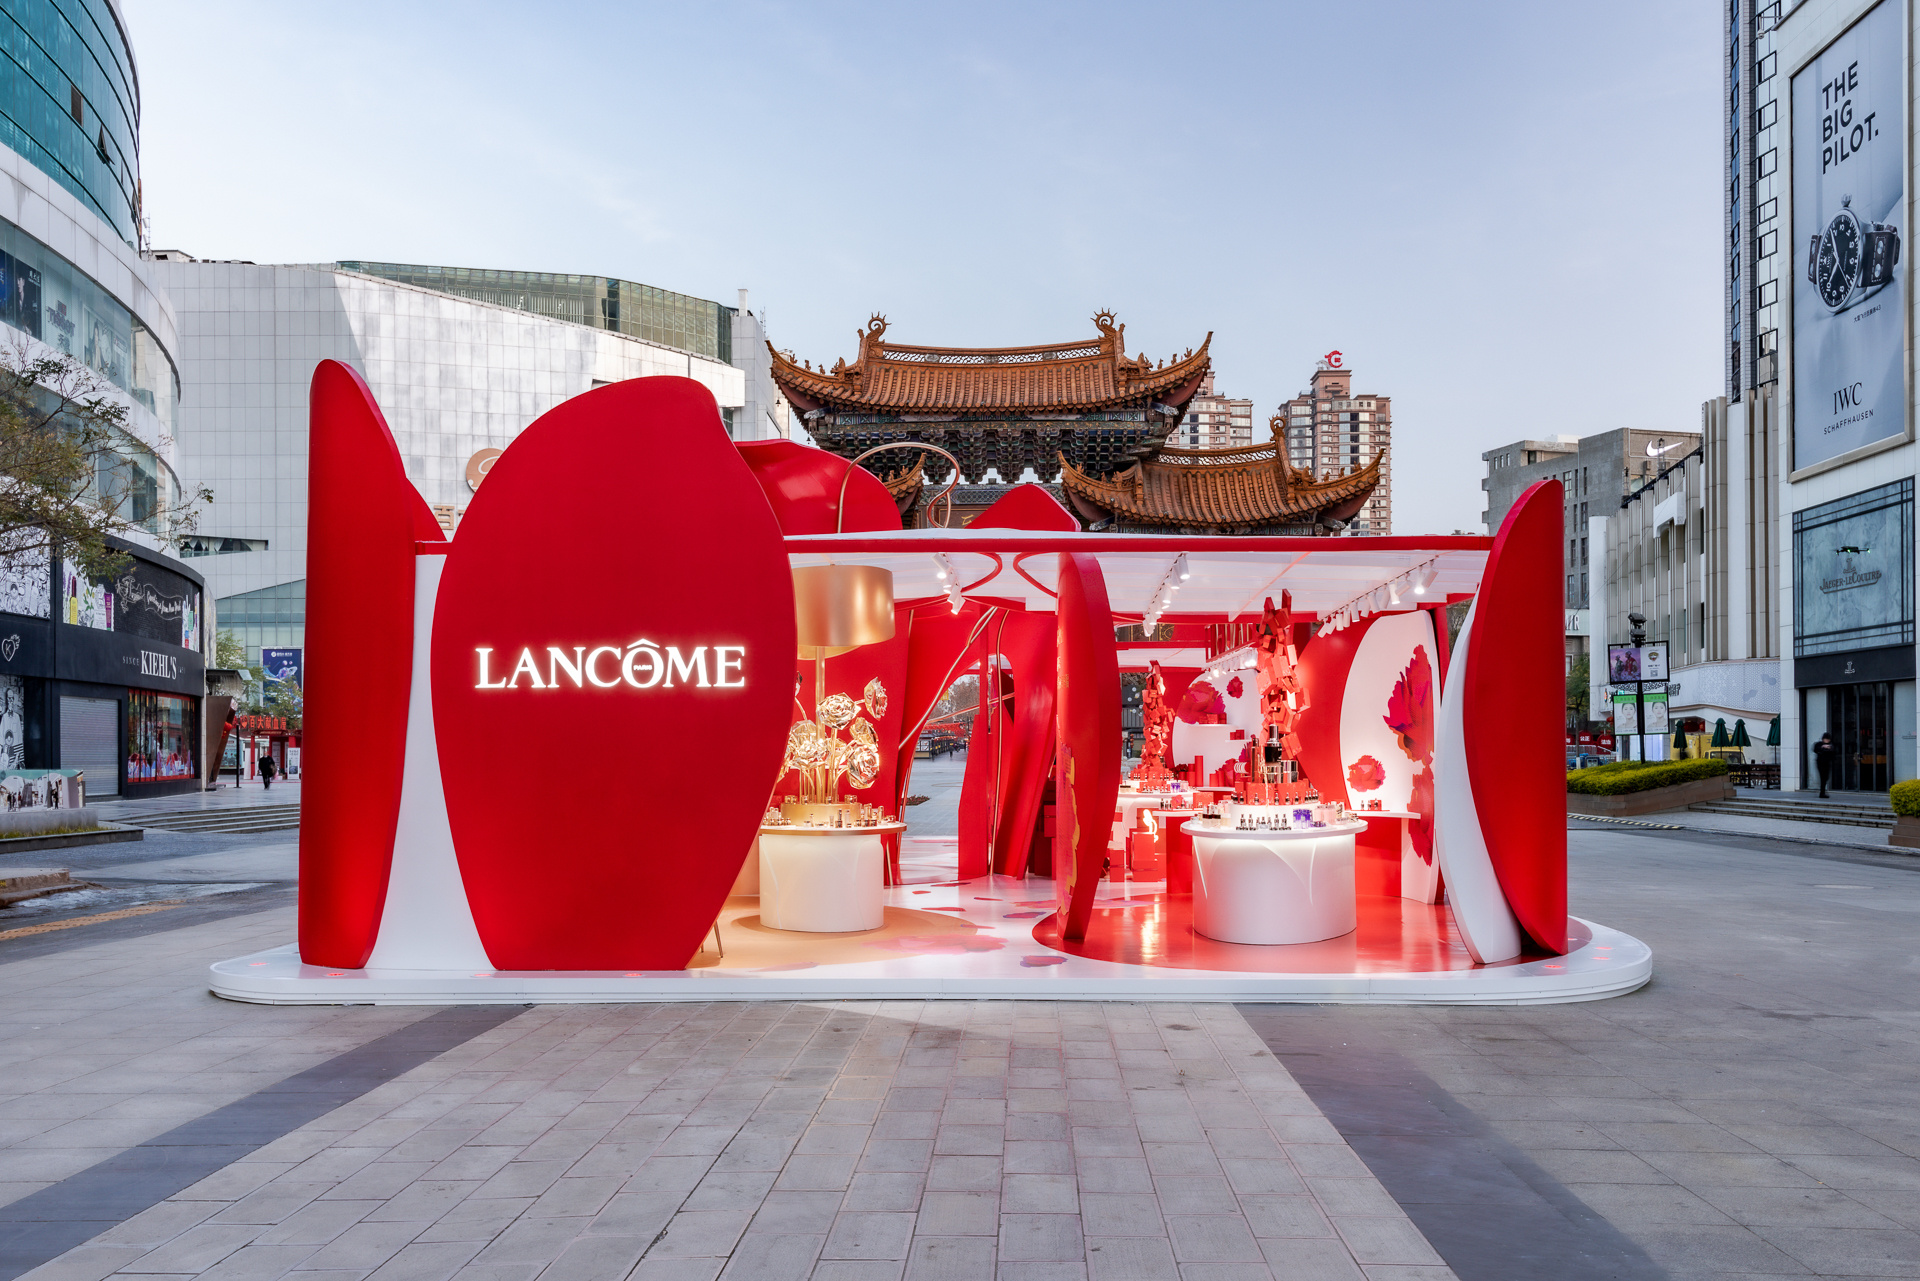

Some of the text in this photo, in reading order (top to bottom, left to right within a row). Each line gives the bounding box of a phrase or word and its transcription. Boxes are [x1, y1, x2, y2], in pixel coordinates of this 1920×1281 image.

[1822, 60, 1859, 110] THE
[1822, 99, 1853, 144] BIG
[1822, 111, 1879, 175] PILOT.
[1833, 382, 1863, 416] IWC
[1823, 409, 1874, 435] SCHAFFHAUSEN
[122, 656, 139, 666] SINCE
[141, 650, 177, 680] KIEHL'S
[475, 638, 745, 689] LANCÔME
[248, 715, 287, 731] 百大献血屋
